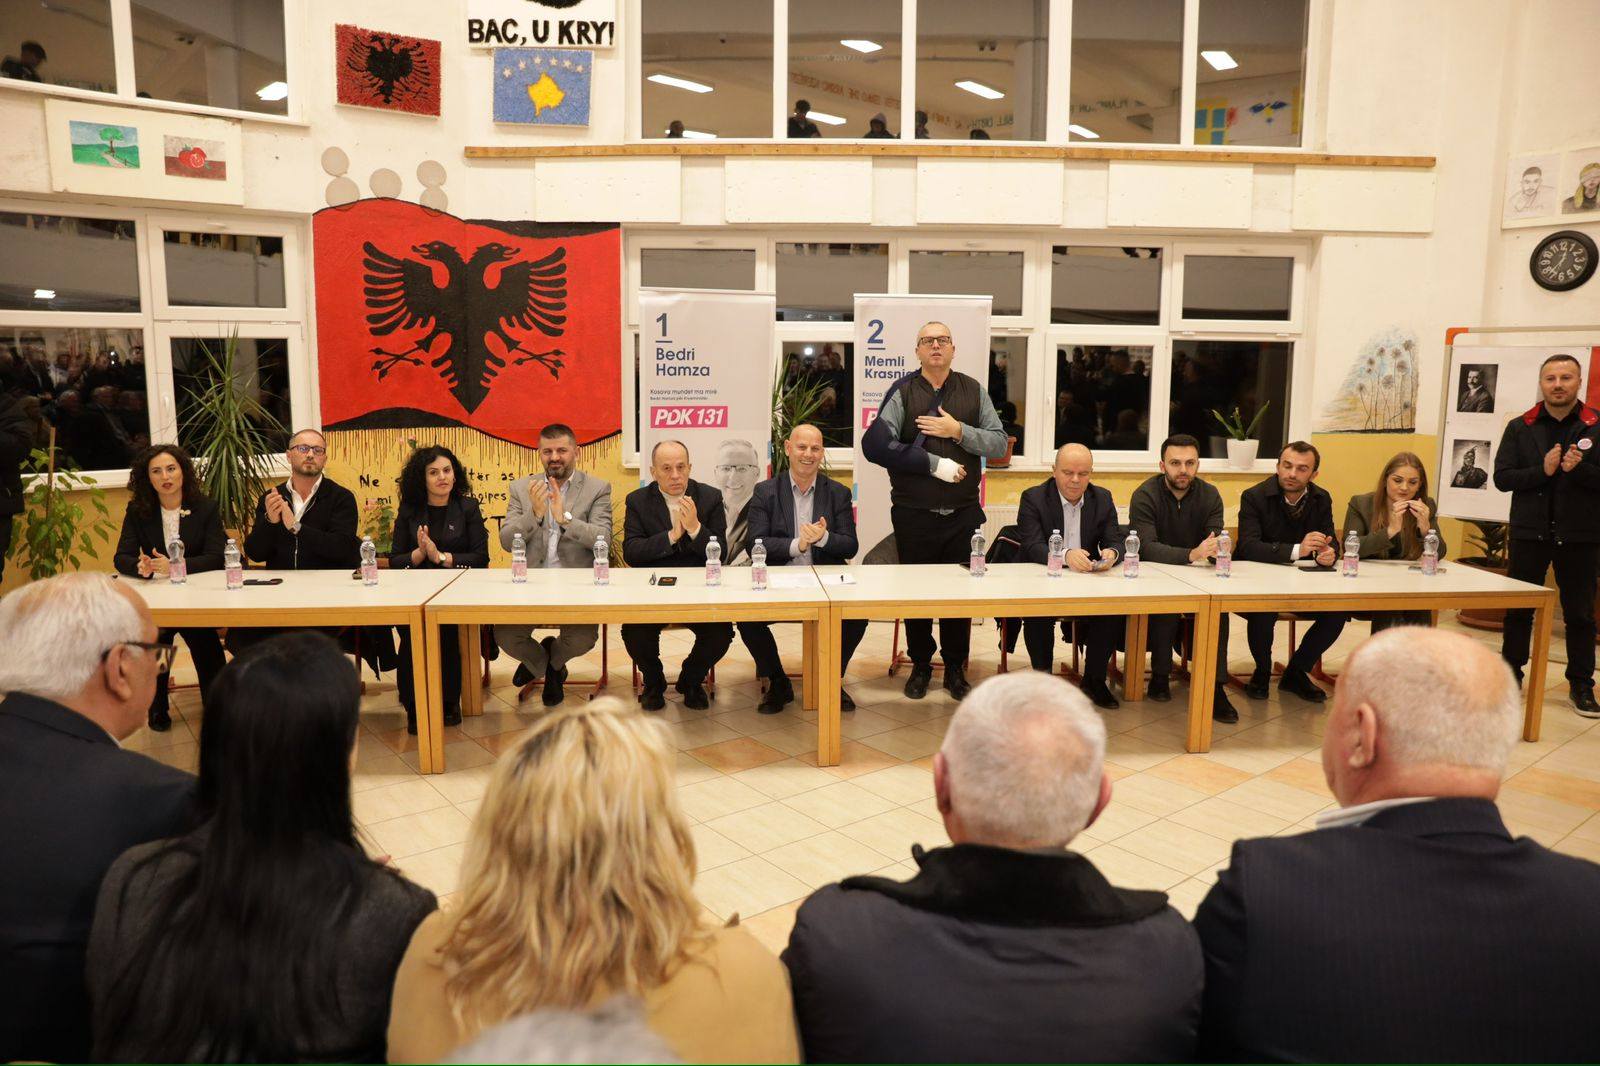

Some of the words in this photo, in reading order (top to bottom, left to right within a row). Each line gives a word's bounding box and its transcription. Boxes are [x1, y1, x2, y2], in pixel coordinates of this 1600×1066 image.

[468, 19, 527, 46] BAC,
[532, 20, 549, 43] U
[558, 20, 615, 45] KRY!
[1559, 241, 1568, 251] 12
[656, 313, 667, 337] 1
[867, 319, 884, 344] 2
[656, 348, 695, 361] Bedri
[864, 356, 905, 367] Memli
[656, 363, 710, 377] Hamza
[864, 368, 912, 379] Krasni
[655, 408, 695, 425] PDK
[697, 408, 724, 425] 131
[360, 474, 379, 488] Ne
[501, 473, 515, 481] as
